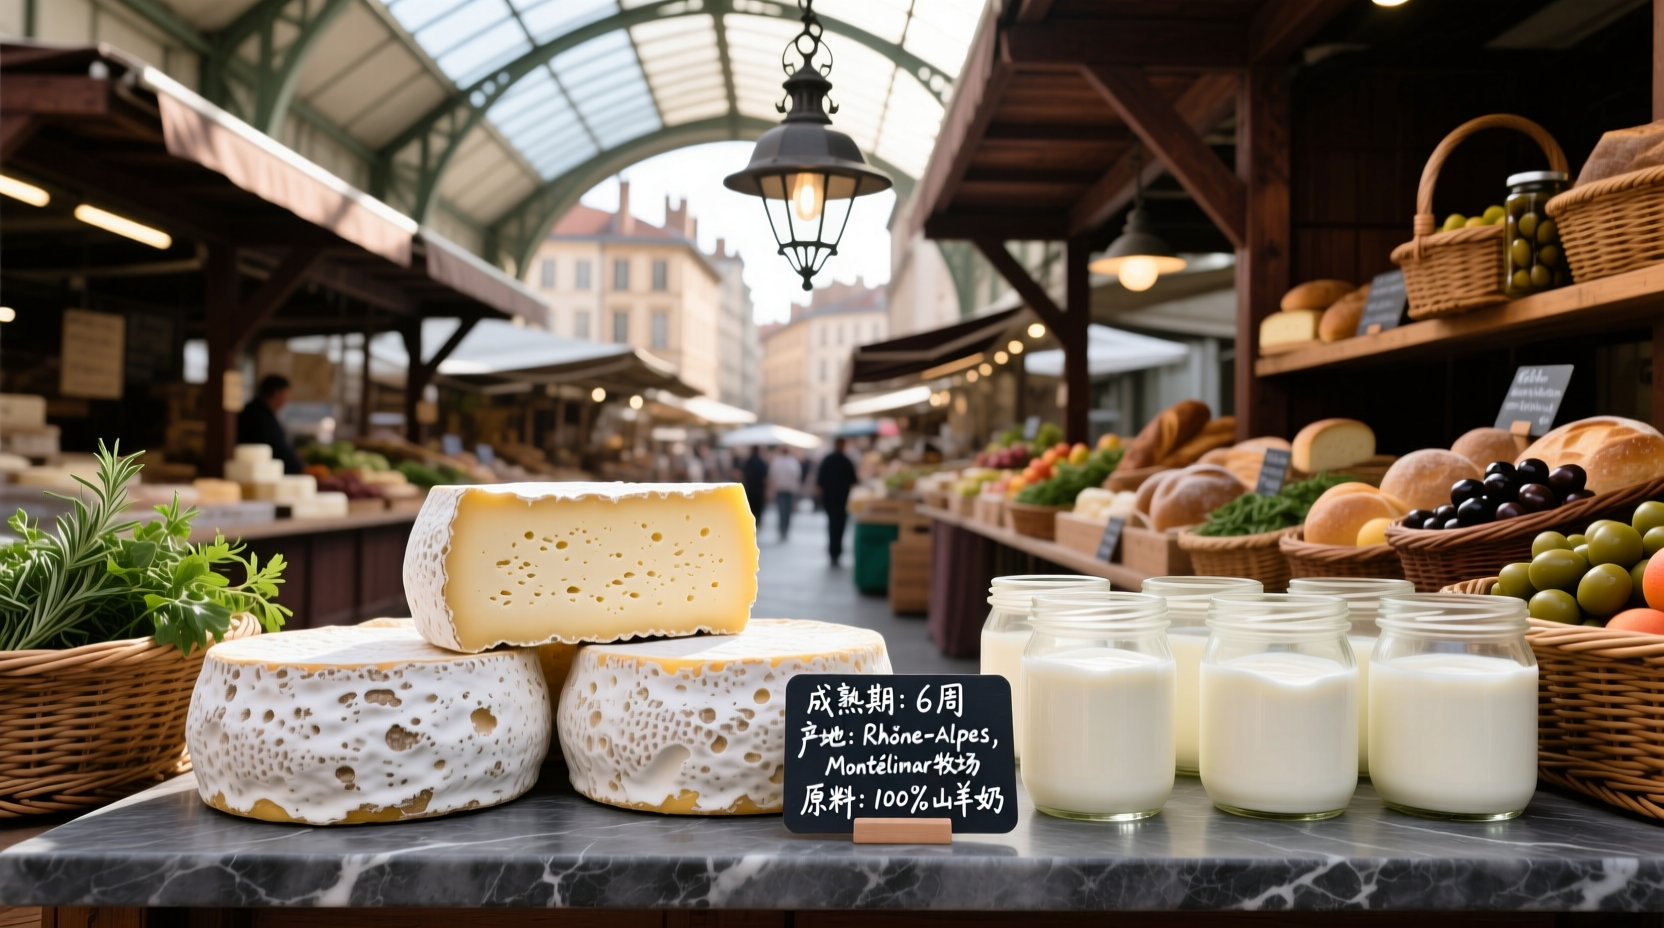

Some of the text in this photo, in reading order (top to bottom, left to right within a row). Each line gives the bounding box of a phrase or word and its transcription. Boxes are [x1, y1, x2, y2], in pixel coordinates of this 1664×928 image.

[915, 682, 964, 718] 6周
[874, 779, 1006, 818] 100%山羊奶
